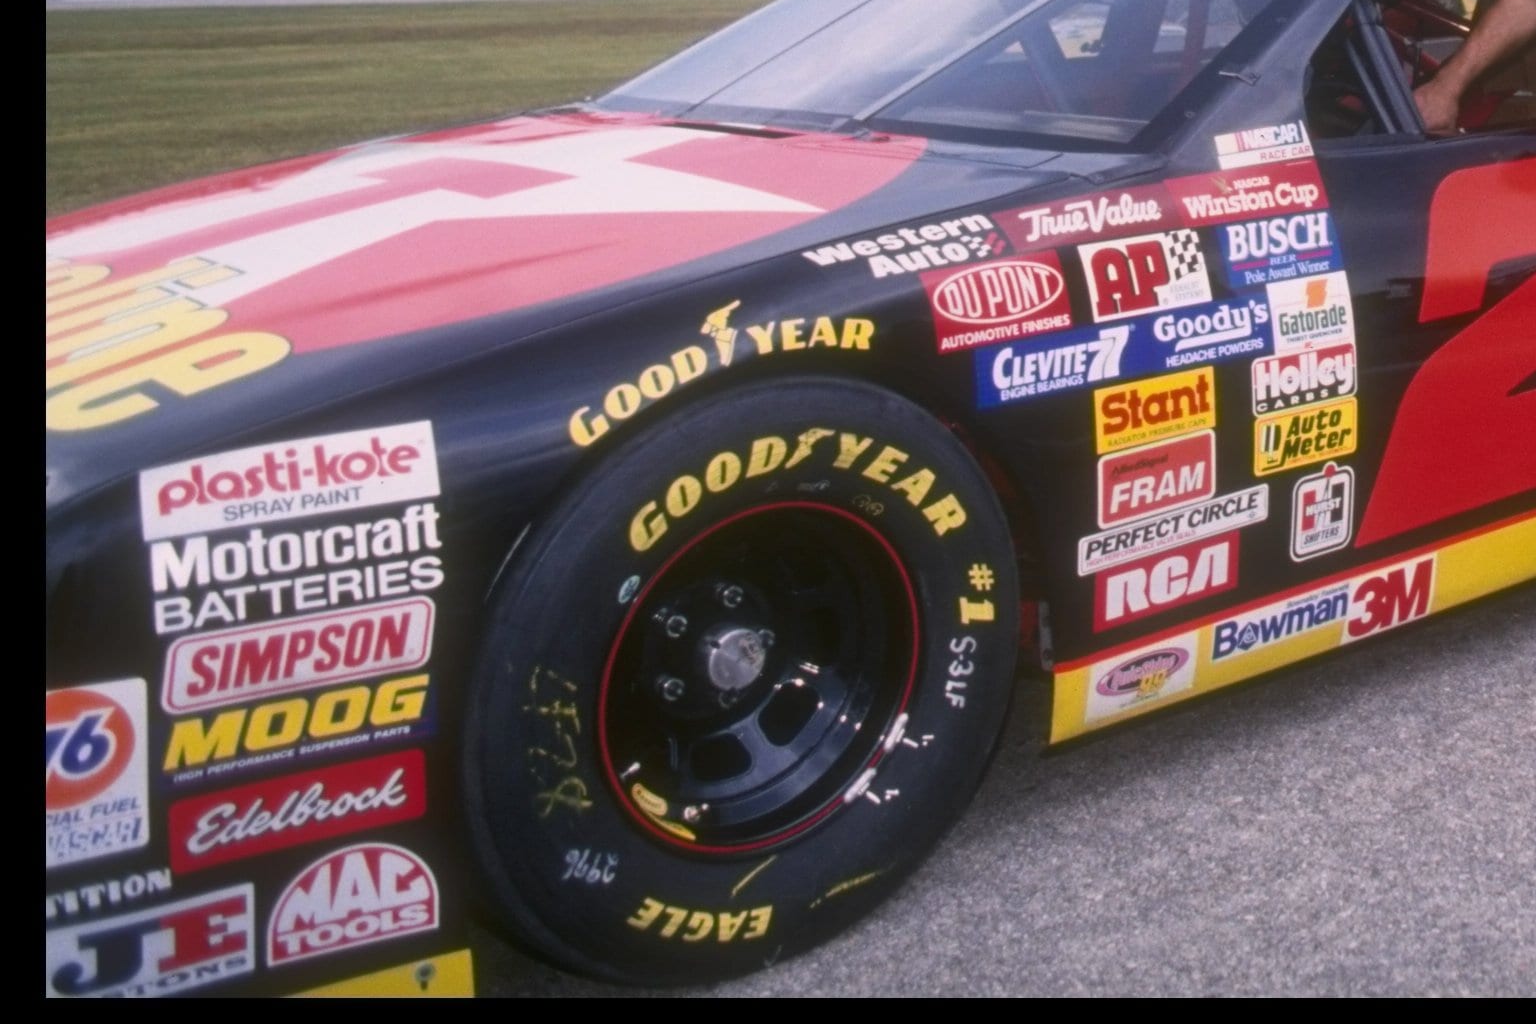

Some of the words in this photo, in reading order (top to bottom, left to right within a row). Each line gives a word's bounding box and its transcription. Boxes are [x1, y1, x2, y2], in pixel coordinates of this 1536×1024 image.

[1260, 150, 1288, 160] RACE
[1291, 145, 1312, 156] CAR
[1182, 188, 1276, 219] Winston
[1275, 182, 1319, 207] Cup
[802, 214, 995, 266] Western
[867, 241, 970, 279] Auto
[1226, 212, 1330, 261] BUSCH
[1091, 240, 1171, 318] AP
[941, 323, 1020, 350] AUTOMOTIVE
[1022, 314, 1071, 334] FINISHES
[1154, 299, 1269, 352] Goody's
[1279, 304, 1348, 337] Gatorade
[992, 343, 1087, 391] CLEVITE
[1166, 348, 1217, 368] HEADACHE
[1218, 337, 1265, 358] POWDERS
[1255, 351, 1354, 401] Holley
[1001, 382, 1036, 401] ENGINE
[1037, 374, 1084, 395] BEARINGS
[1101, 374, 1211, 436] Stant
[1256, 388, 1329, 413] CARBS
[1283, 428, 1353, 460] Meter
[1286, 408, 1342, 439] Auto
[158, 436, 420, 516] plasti-kote
[1109, 461, 1206, 515] FRAM
[223, 497, 295, 523] SPRAY
[300, 486, 364, 509] PAINT
[1085, 513, 1185, 561] PERFECT
[1187, 491, 1260, 529] CIRCLE
[150, 503, 442, 593] Motorcraft
[153, 555, 445, 636] BATTERIES
[1105, 541, 1230, 622] RCA
[1347, 557, 1435, 638] 3M
[1212, 591, 1349, 661] Bowman
[186, 611, 413, 699] SIMPSON
[163, 674, 430, 772] MOOG
[207, 749, 295, 777] PERFORMANCE
[299, 733, 369, 756] SUSPENSION
[373, 725, 411, 739] PARTS
[90, 797, 141, 818] FUEL
[186, 767, 408, 855] Edelbrock
[46, 866, 173, 919] TITION
[288, 850, 430, 933] MAC
[51, 894, 248, 997] JE
[276, 902, 430, 956] TOOLS
[626, 896, 774, 943] EAGLE
